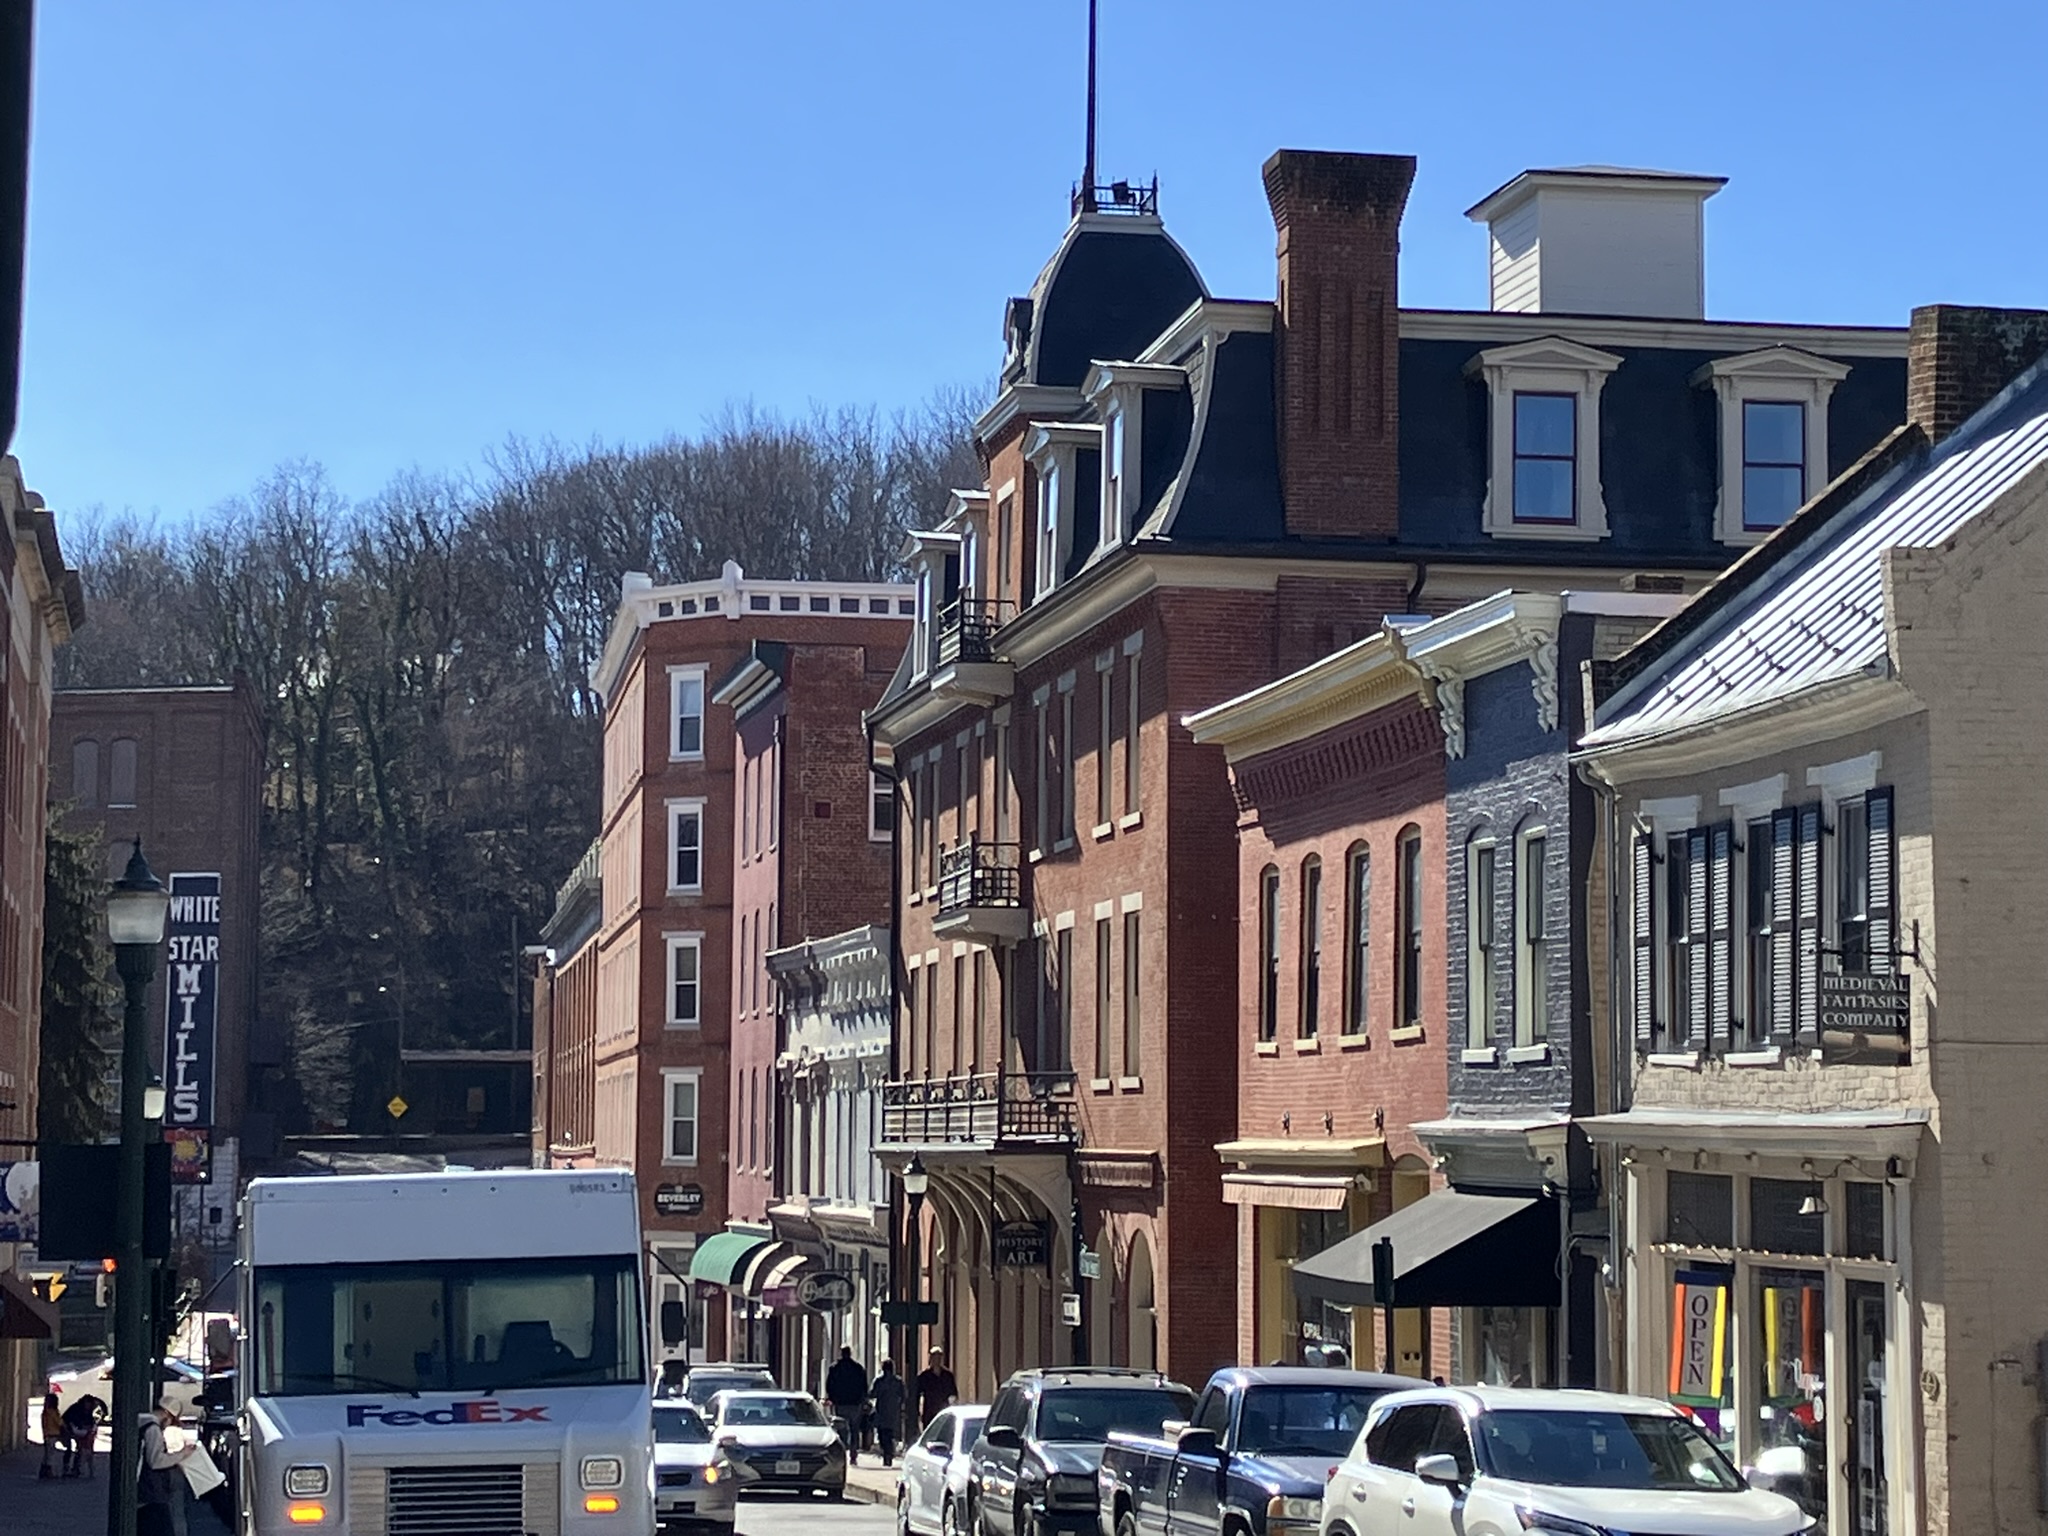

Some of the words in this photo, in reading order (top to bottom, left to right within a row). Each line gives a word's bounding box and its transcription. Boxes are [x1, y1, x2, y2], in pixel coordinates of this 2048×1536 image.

[170, 896, 220, 923] WHITE
[168, 935, 219, 961] STAR
[1823, 976, 1908, 991] MEDIEVAL
[1822, 993, 1909, 1009] FANTASIES
[1822, 1012, 1909, 1027] COMPANY
[173, 964, 202, 1122] MILLS
[1006, 1250, 1037, 1264] ART
[1687, 1294, 1709, 1386] OPEN
[347, 1401, 552, 1428] FedEx
